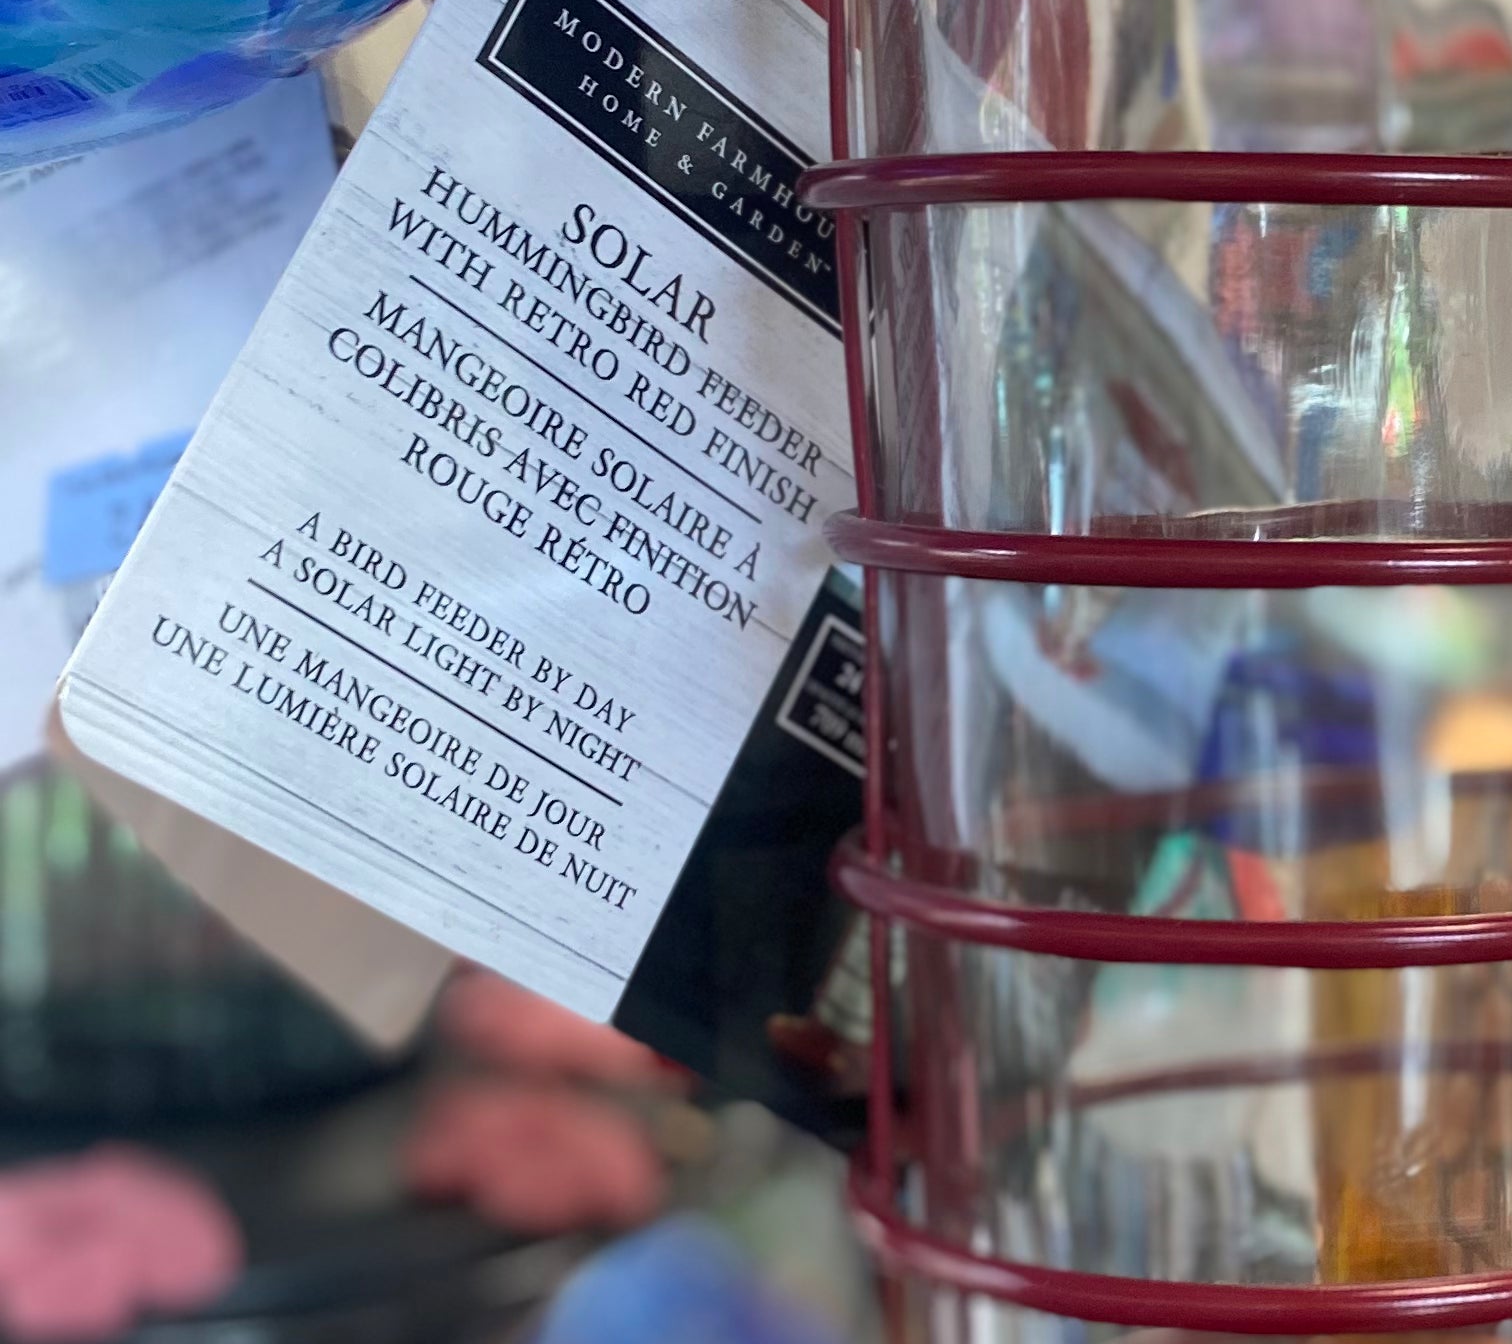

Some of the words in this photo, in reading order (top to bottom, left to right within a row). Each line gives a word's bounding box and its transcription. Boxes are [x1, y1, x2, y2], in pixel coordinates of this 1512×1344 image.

[553, 8, 687, 121] MODERN
[696, 122, 835, 238] FARMHOU
[578, 74, 661, 147] HOME
[677, 154, 694, 175] &
[388, 198, 496, 292] WITH
[498, 279, 619, 382] RETRO
[624, 371, 697, 437] RED
[701, 427, 819, 524] FINISH
[420, 166, 691, 377] HUMMINGBIRD
[697, 367, 823, 478] FEEDER
[562, 203, 717, 344] SOLAR
[328, 328, 503, 457] COLIBRIS
[503, 447, 601, 527] AVEC
[602, 511, 758, 632] FINITION
[363, 290, 588, 460] MANGEOIRE
[592, 448, 733, 559] SOLAIRE
[734, 543, 761, 581] À
[401, 433, 534, 539] ROUGE
[534, 523, 650, 615] RÉTRO
[219, 602, 292, 662] UNE
[294, 649, 483, 776] MANGEOIRE
[485, 763, 530, 804] DE
[528, 791, 605, 851] JOUR
[260, 538, 284, 569] A
[294, 557, 396, 636] SOLAR
[401, 626, 501, 696] LIGHT
[502, 685, 545, 723] BY
[548, 712, 643, 783] NIGHT
[296, 511, 322, 542] A
[329, 528, 407, 590] BIRD
[413, 581, 527, 670] FEEDER
[531, 657, 574, 694] BY
[574, 682, 636, 734] DAY
[152, 615, 229, 675] UNE
[231, 662, 382, 764] LUMIÈRE
[384, 752, 512, 841] SOLAIRE
[514, 828, 556, 867] DE
[559, 854, 637, 911] NUIT
